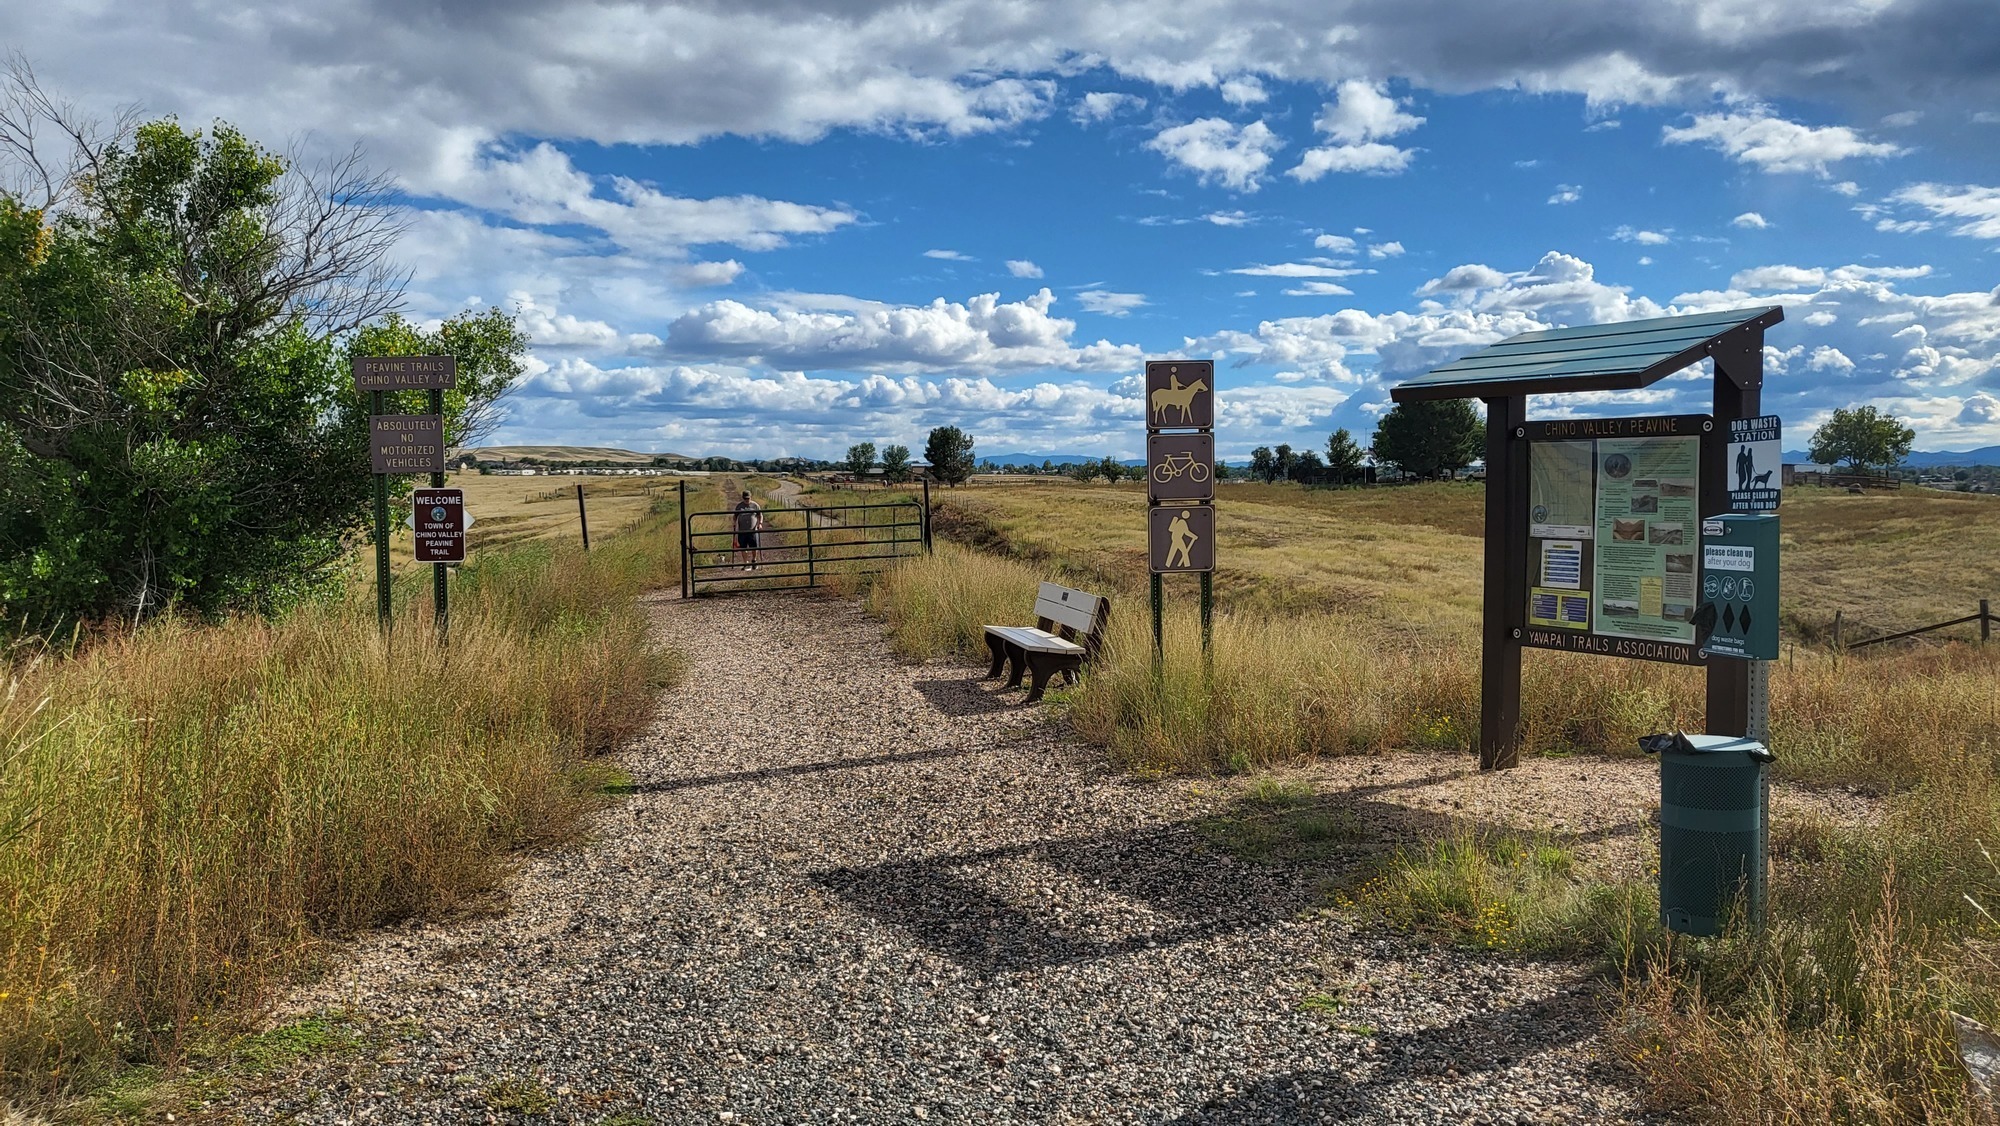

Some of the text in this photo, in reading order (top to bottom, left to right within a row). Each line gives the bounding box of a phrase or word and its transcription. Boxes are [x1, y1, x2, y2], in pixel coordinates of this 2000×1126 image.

[366, 361, 445, 373] PEAVINE TRAILS
[360, 375, 390, 385] CHINO
[438, 374, 450, 384] AZ
[377, 421, 437, 431] ABSOLUTELY
[1545, 418, 1678, 436] CHINO VALLEY PEAVINE
[1731, 416, 1777, 431] DOG WASTE
[401, 433, 414, 443] NO
[1734, 430, 1775, 442] STATION
[381, 445, 435, 455] MOTORIZED
[386, 457, 431, 468] VEHICLES
[416, 496, 461, 505] WELCOME
[1731, 491, 1777, 500] PLEASE CLEAN UP
[1732, 501, 1777, 510] AFTER YOUR DOG
[424, 522, 444, 530] TOWN
[1705, 547, 1753, 559] please clean up
[1707, 557, 1751, 569] after your dog
[1529, 631, 1690, 661] YAVAPAI TRAILS ASSOCIATION
